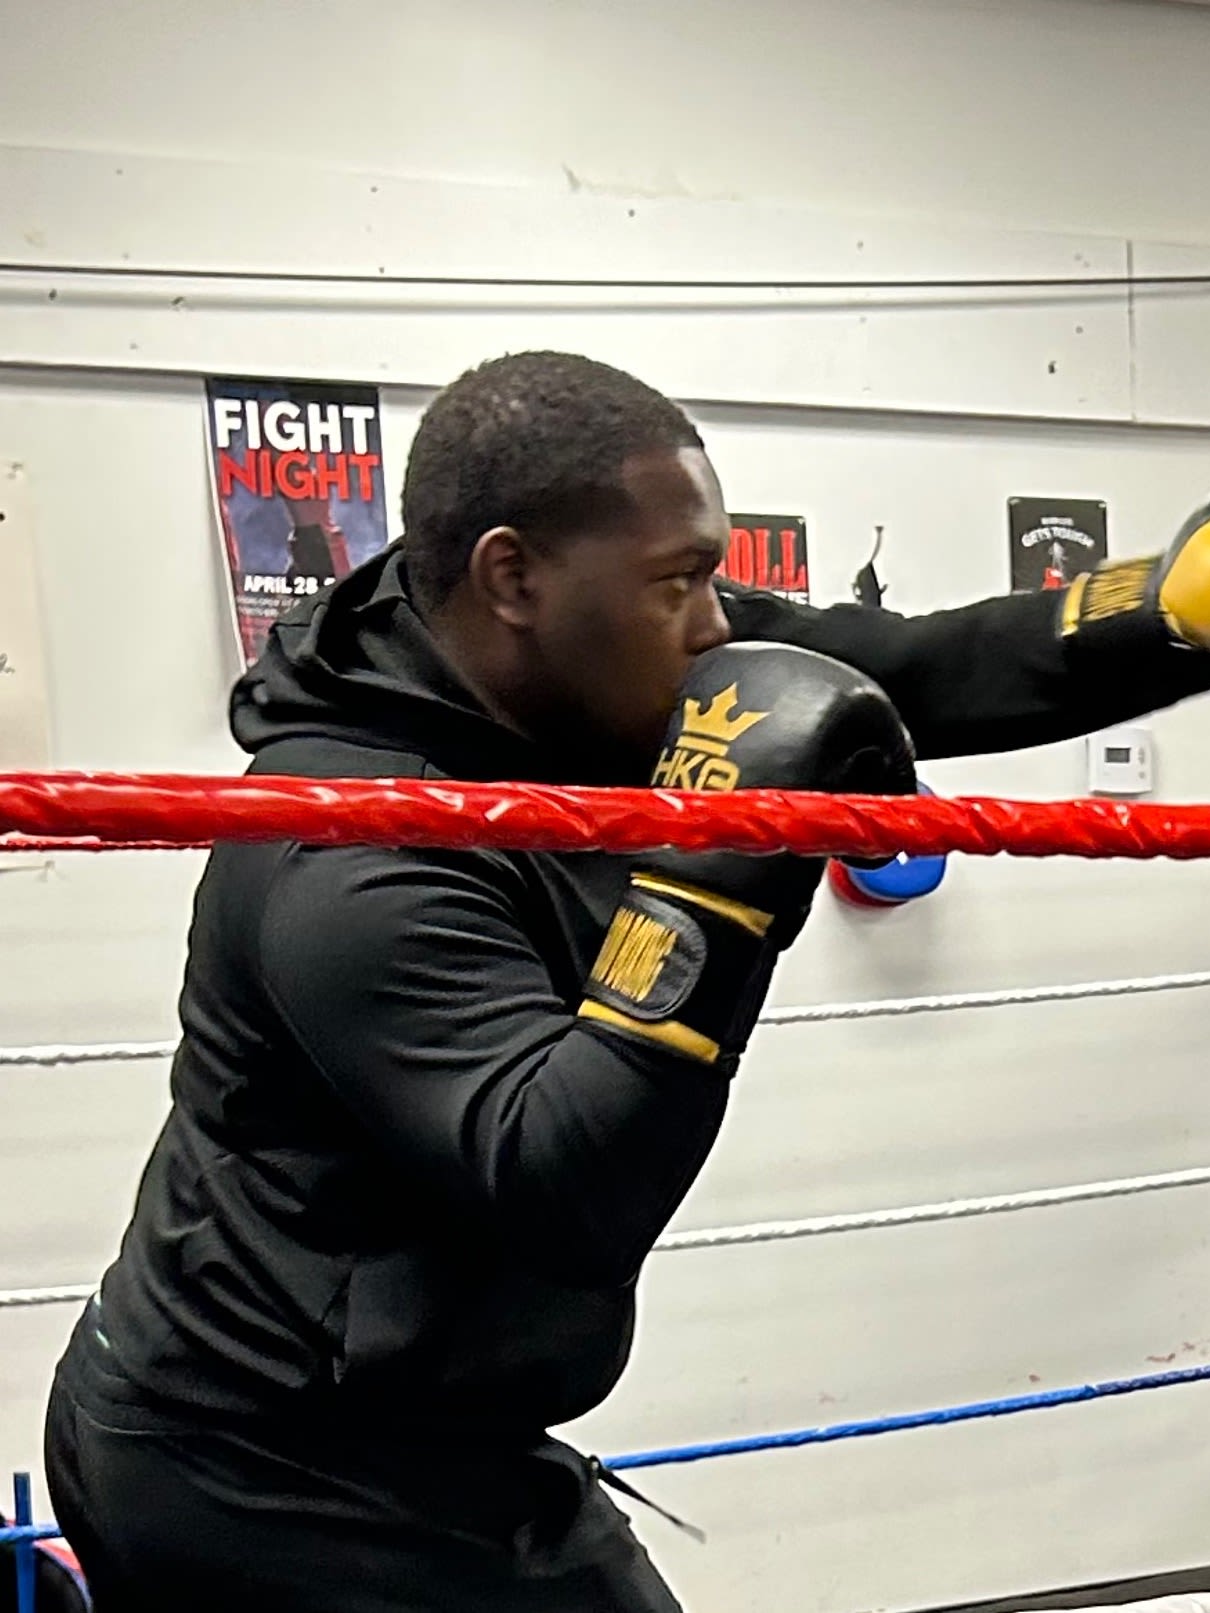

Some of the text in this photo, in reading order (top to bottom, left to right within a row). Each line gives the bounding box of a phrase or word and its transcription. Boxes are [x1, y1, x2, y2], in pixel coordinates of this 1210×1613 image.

[214, 398, 375, 454] FIGHT
[219, 449, 380, 501] NIGHT
[244, 575, 293, 595] APRIL
[293, 576, 319, 595] 28
[715, 527, 806, 592] OLL
